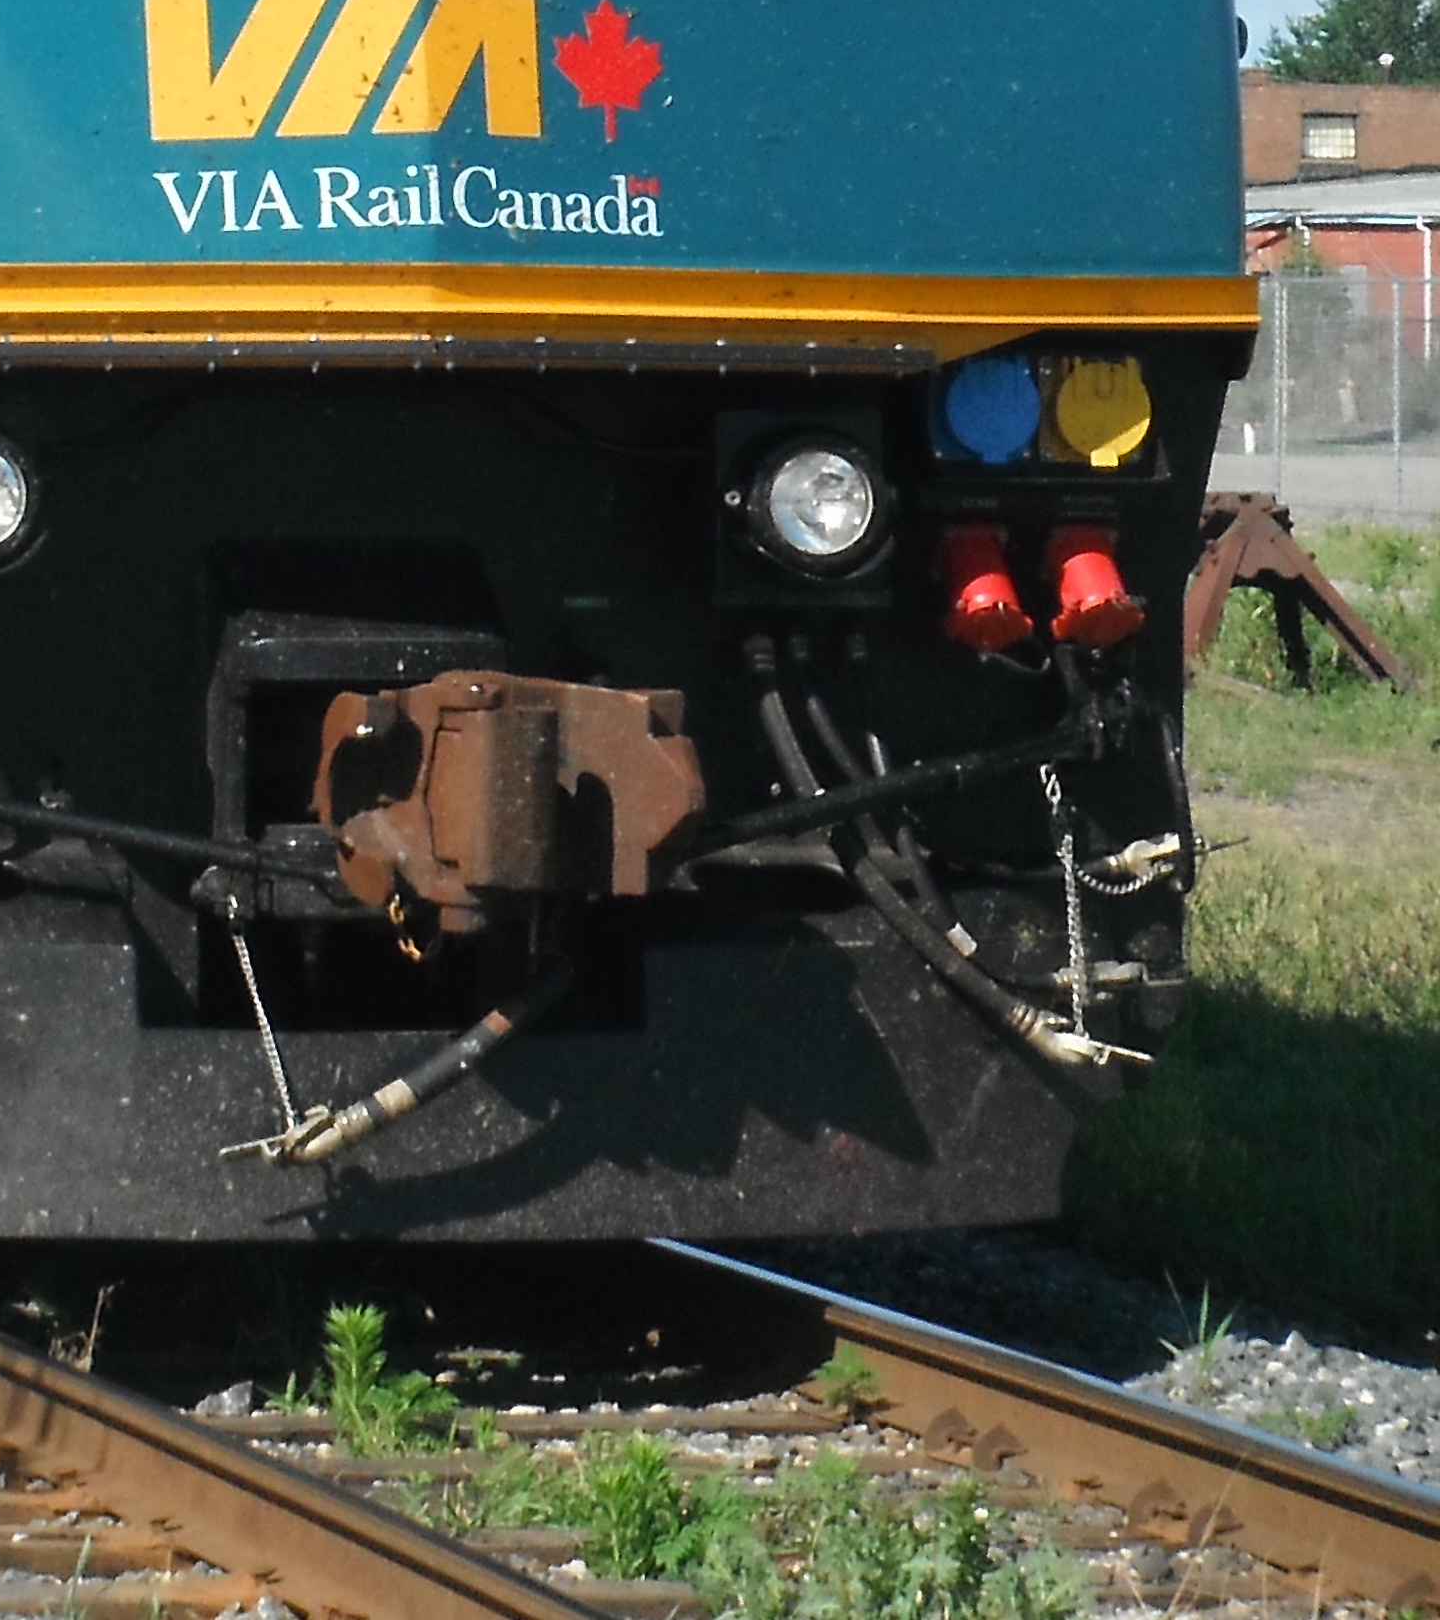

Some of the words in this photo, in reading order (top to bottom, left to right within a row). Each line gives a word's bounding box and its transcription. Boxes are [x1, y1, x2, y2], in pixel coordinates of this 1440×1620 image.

[152, 169, 303, 234] VIA
[313, 164, 445, 230] Rail
[452, 166, 664, 237] Canada
